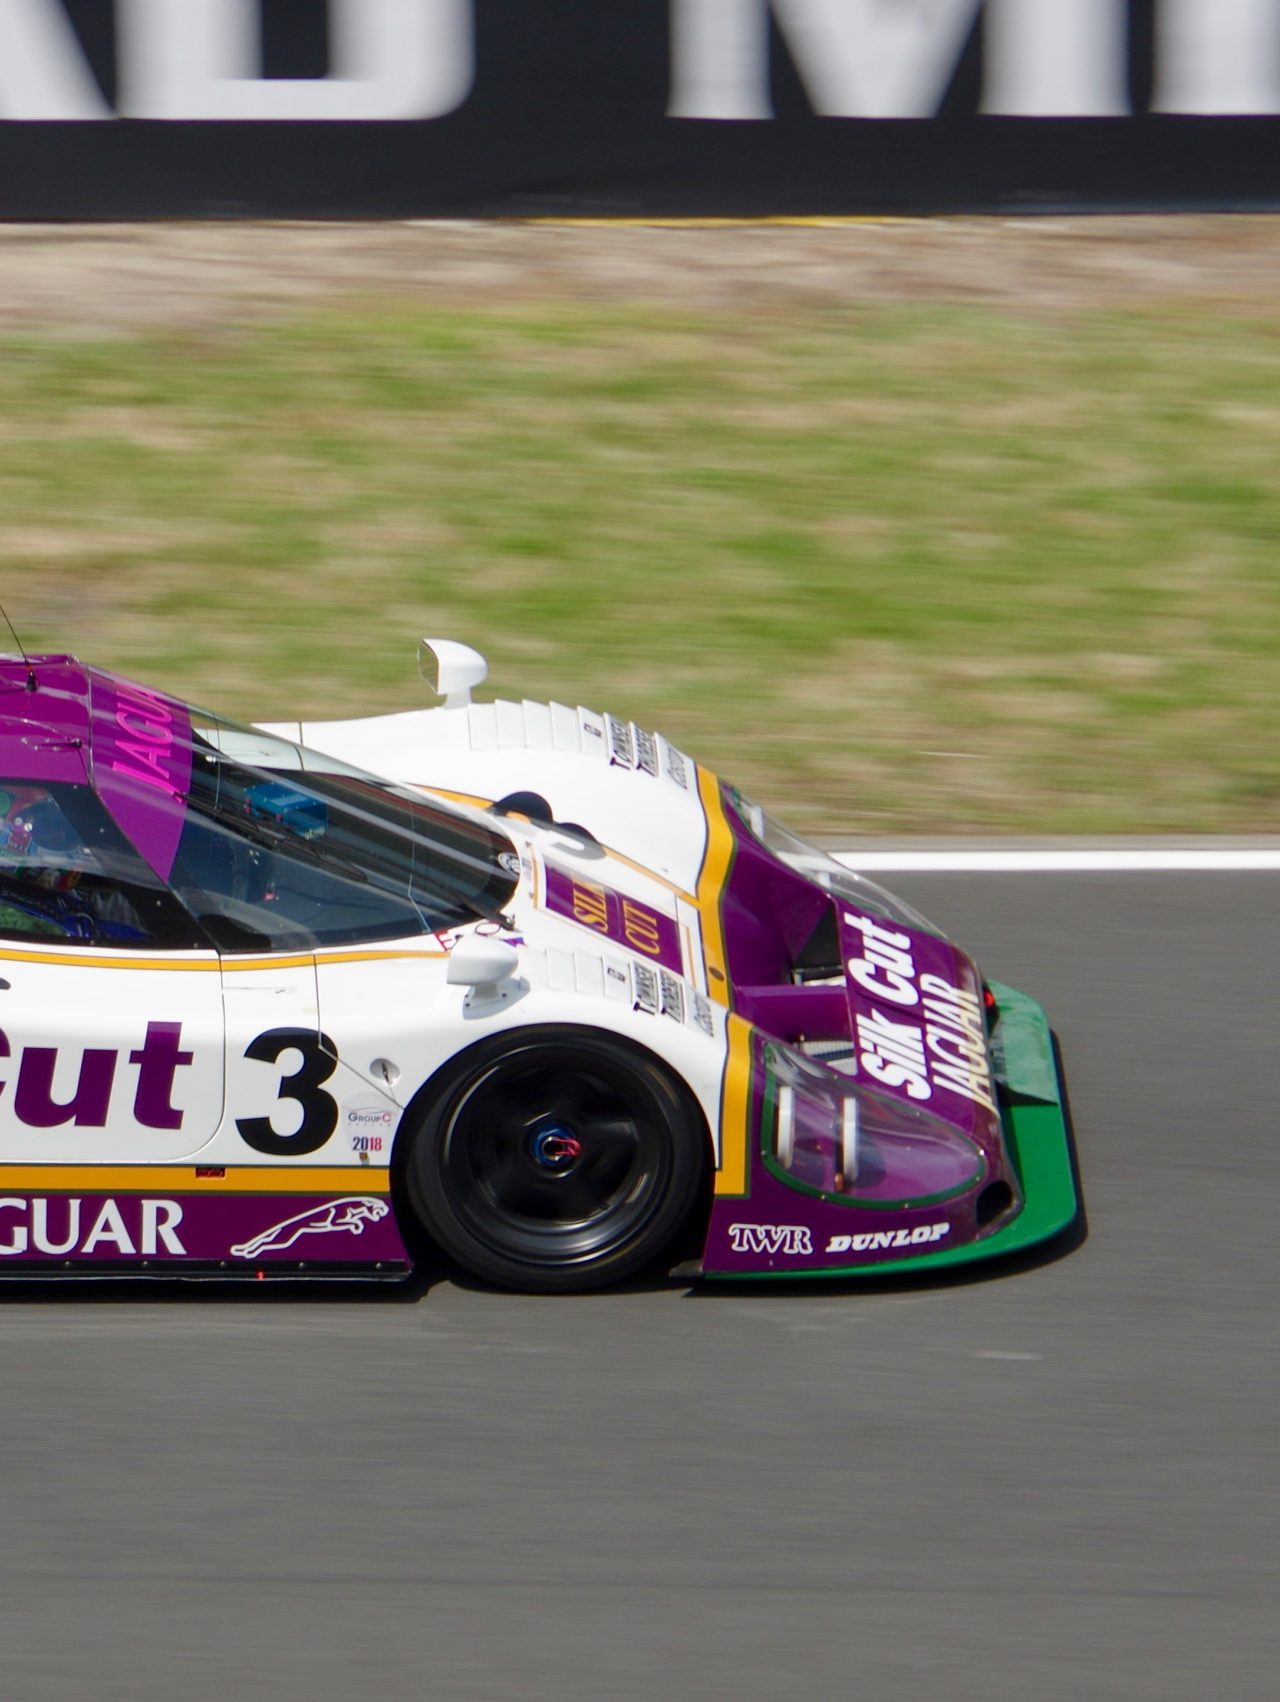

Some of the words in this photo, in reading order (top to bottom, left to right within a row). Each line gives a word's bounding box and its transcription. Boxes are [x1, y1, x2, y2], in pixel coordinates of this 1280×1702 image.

[622, 898, 660, 955] CUT
[844, 911, 919, 1006] Cut
[855, 1008, 932, 1101] Silk
[920, 972, 1001, 1121] JAGUAR
[234, 1026, 340, 1157] 3
[352, 1135, 383, 1152] 2018
[728, 1223, 814, 1255] TWR
[825, 1222, 951, 1253] DUNLOP
